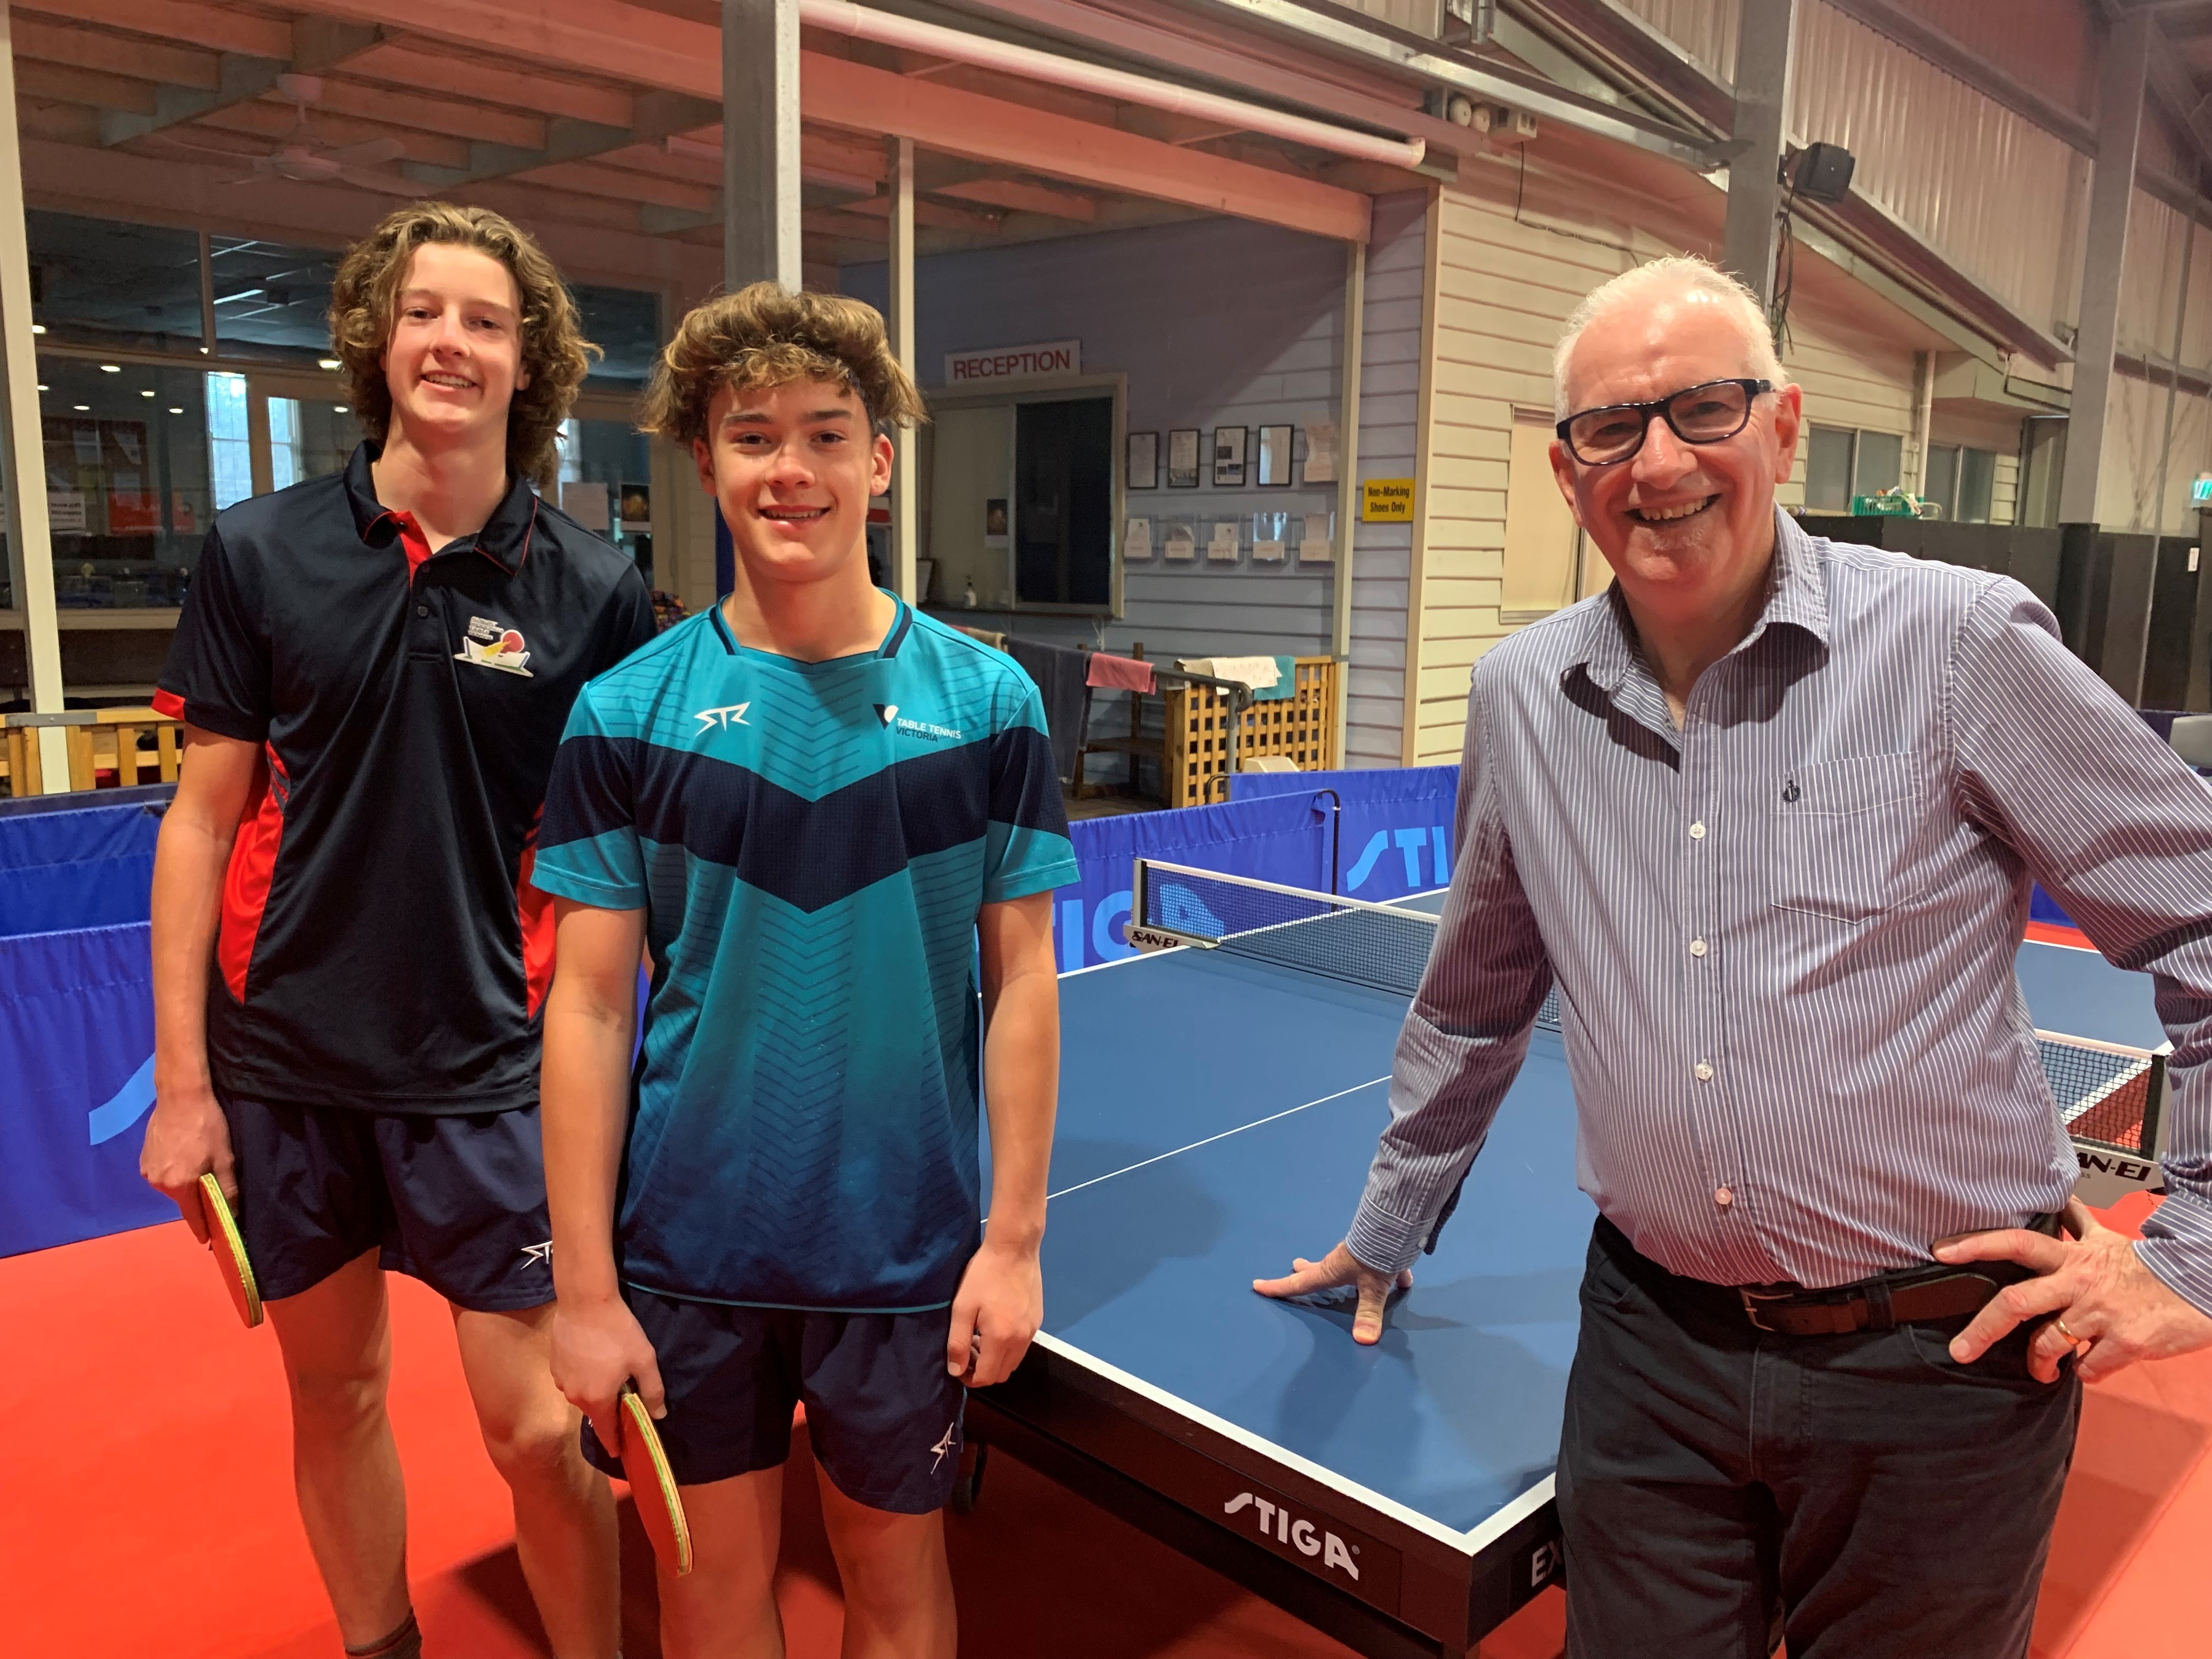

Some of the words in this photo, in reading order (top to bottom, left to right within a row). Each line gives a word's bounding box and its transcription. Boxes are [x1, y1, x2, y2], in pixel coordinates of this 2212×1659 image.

[953, 349, 1070, 380] RECEPTION
[1368, 486, 1409, 499] Non-Marking
[1370, 501, 1389, 512] Shoes
[1391, 501, 1406, 514] Only
[896, 727, 938, 742] VICTORIA
[897, 718, 927, 731] TABLE
[929, 724, 961, 739] TENNIS
[1347, 826, 1449, 892] STI
[1053, 883, 1224, 973] IGA
[2077, 1152, 2151, 1181] AN-EI
[1224, 1492, 1359, 1581] STIGA
[1531, 1538, 1562, 1587] EX
